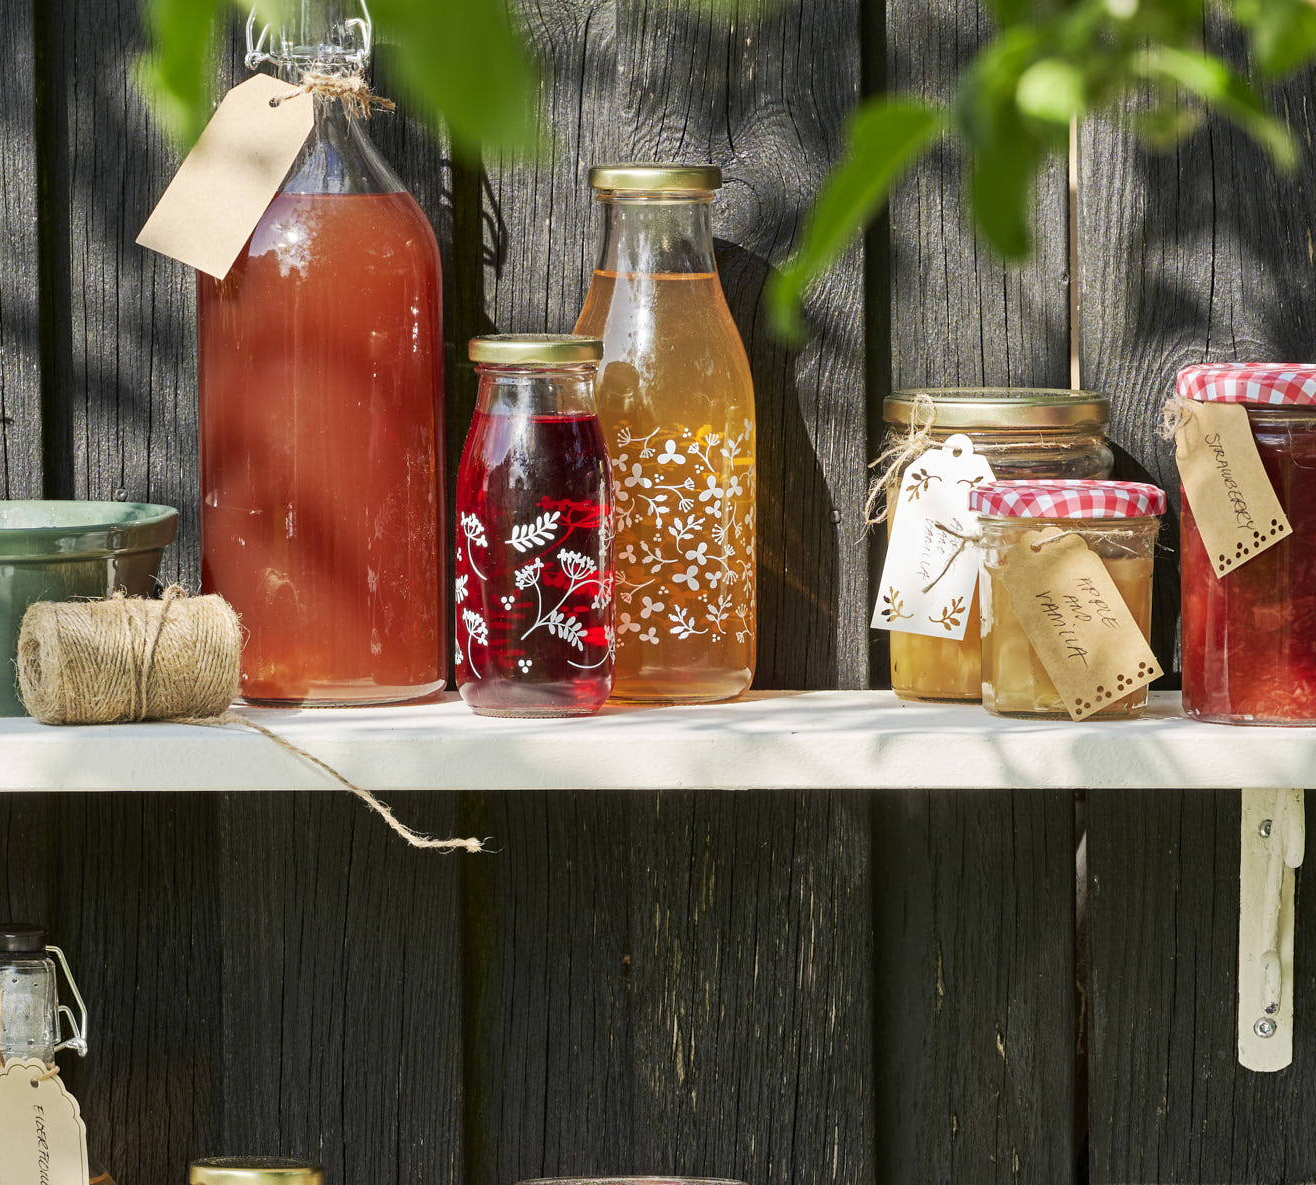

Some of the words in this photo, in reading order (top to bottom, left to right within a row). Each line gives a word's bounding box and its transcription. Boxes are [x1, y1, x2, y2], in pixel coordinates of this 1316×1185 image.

[1204, 432, 1256, 531] STRAWBERRY
[1063, 595, 1091, 622] AND
[1073, 577, 1120, 630] APPLE
